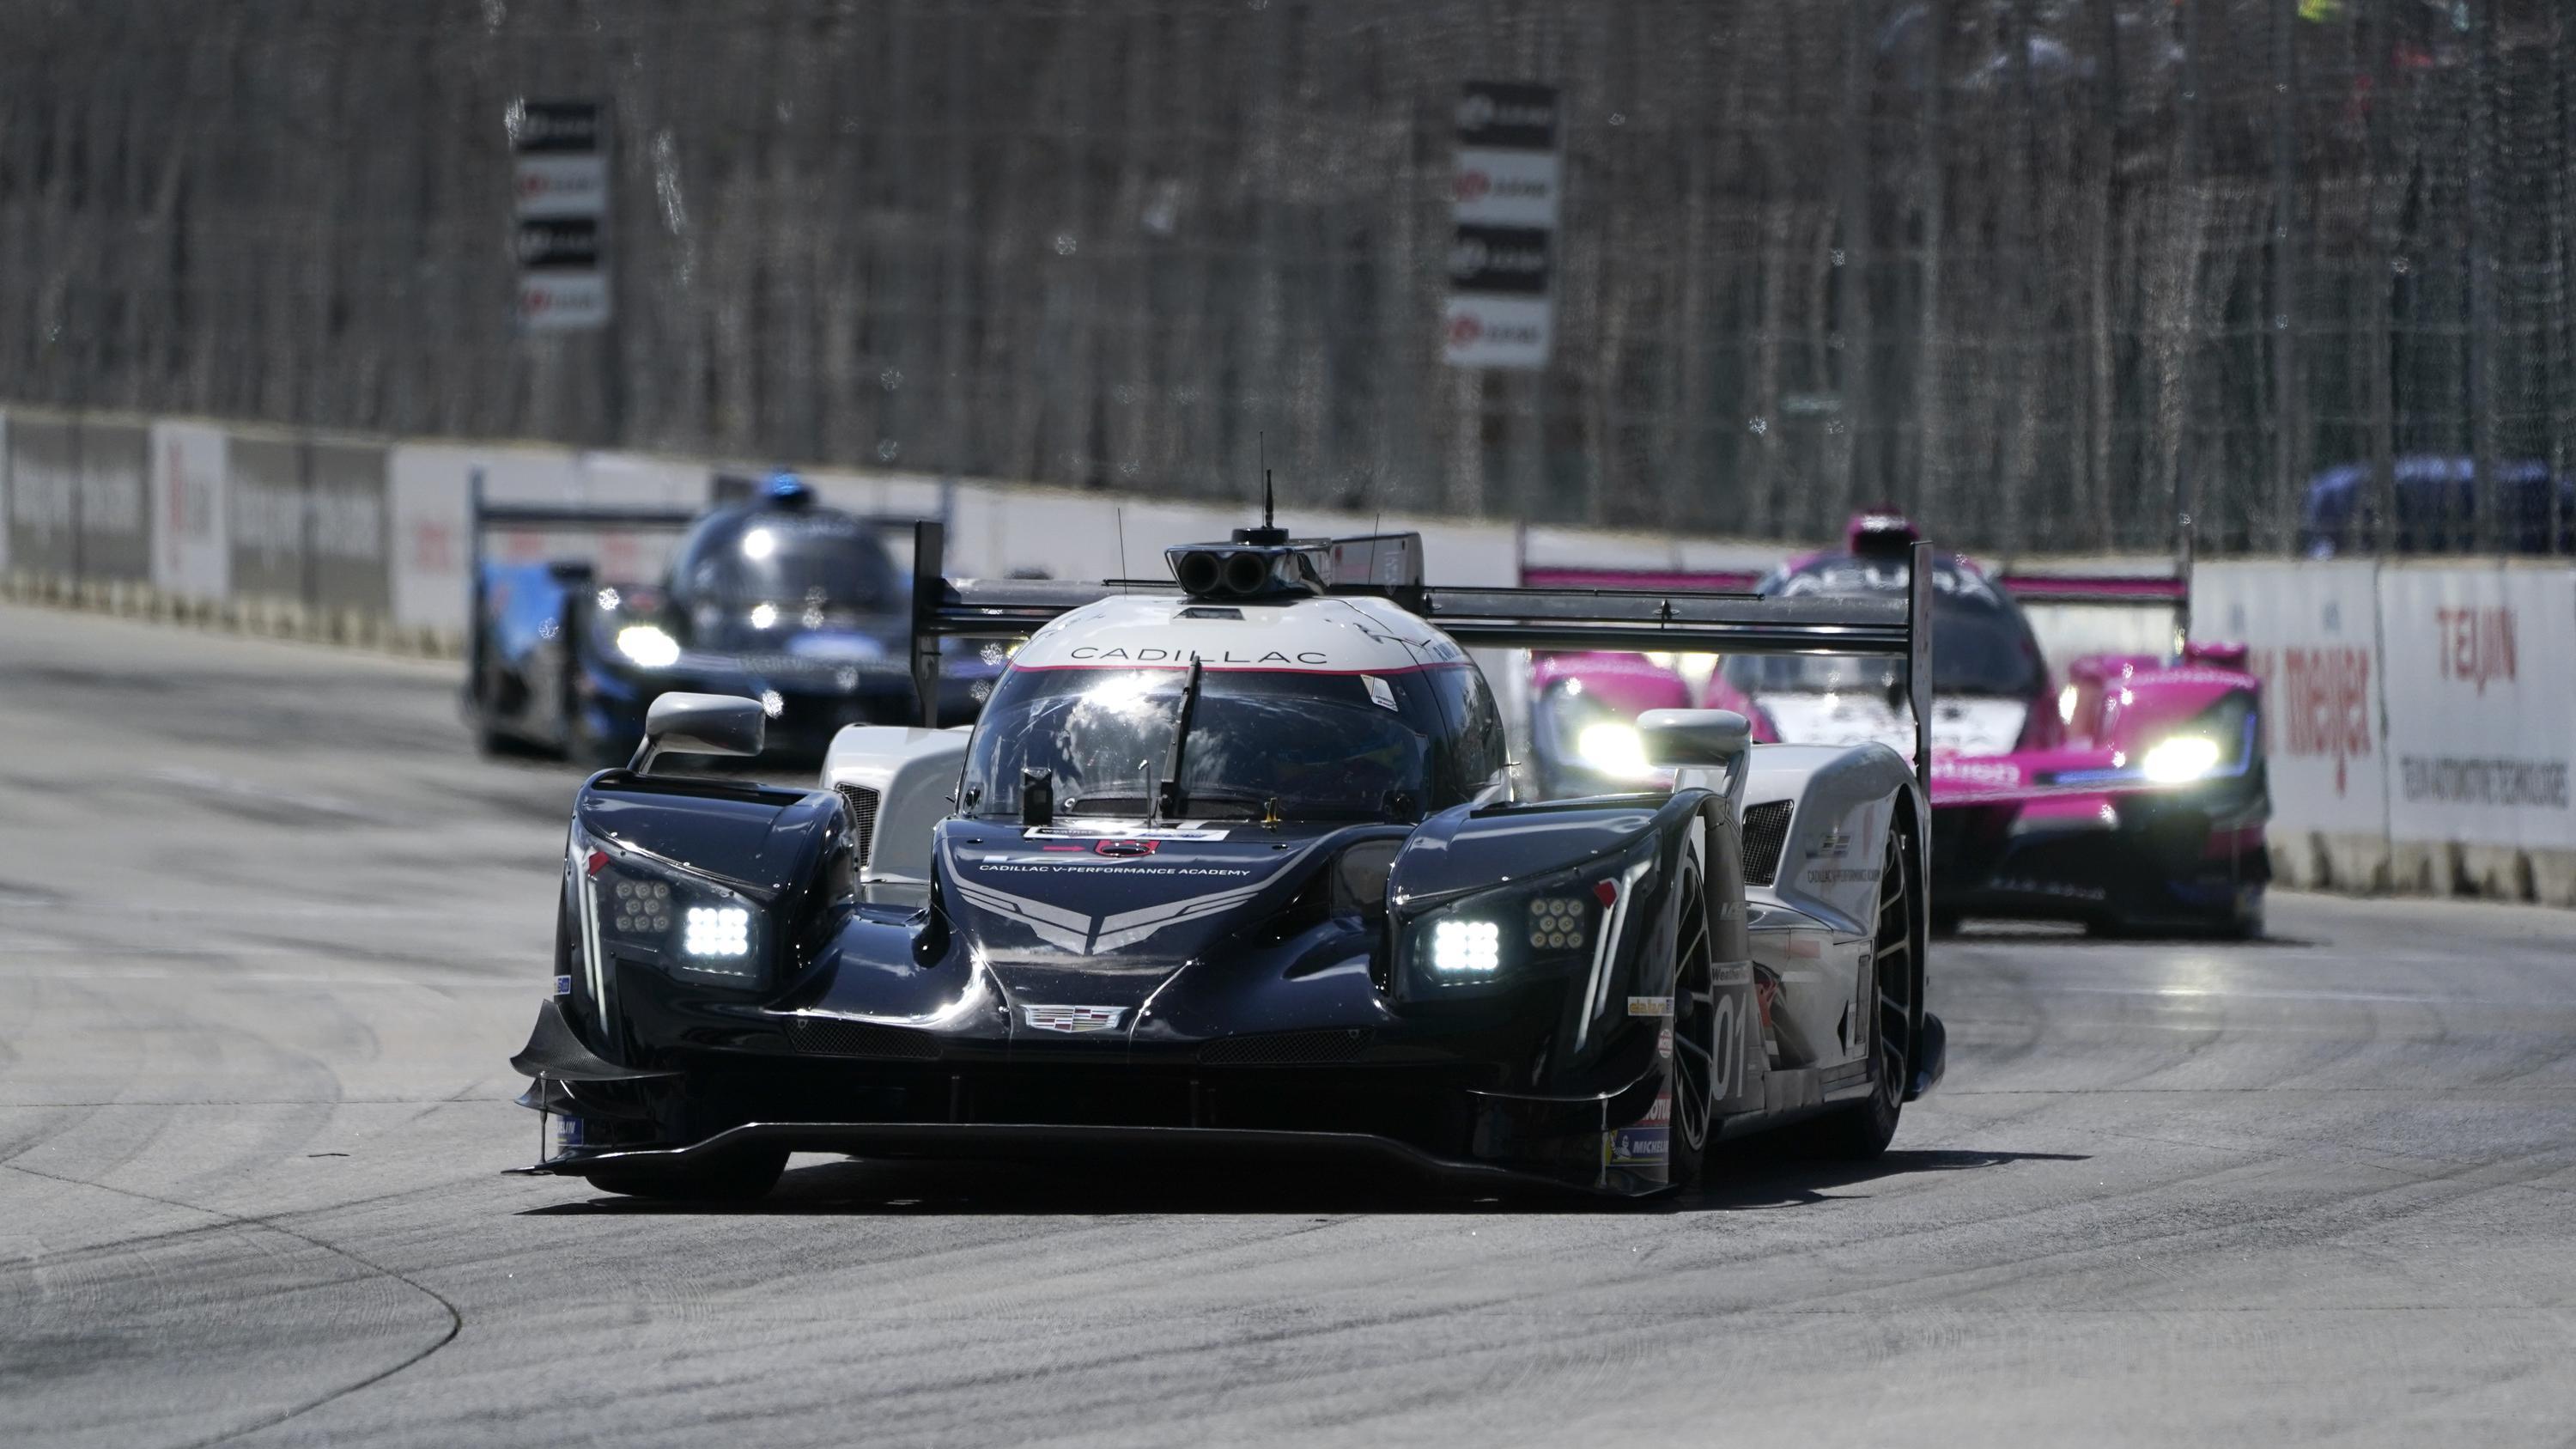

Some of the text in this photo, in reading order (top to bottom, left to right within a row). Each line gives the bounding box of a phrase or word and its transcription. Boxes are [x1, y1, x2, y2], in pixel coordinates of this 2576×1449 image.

[1071, 647, 1327, 665] CADILLAC
[1053, 866, 1176, 874] V-PERFORMANCE
[1711, 992, 1747, 1101] 01
